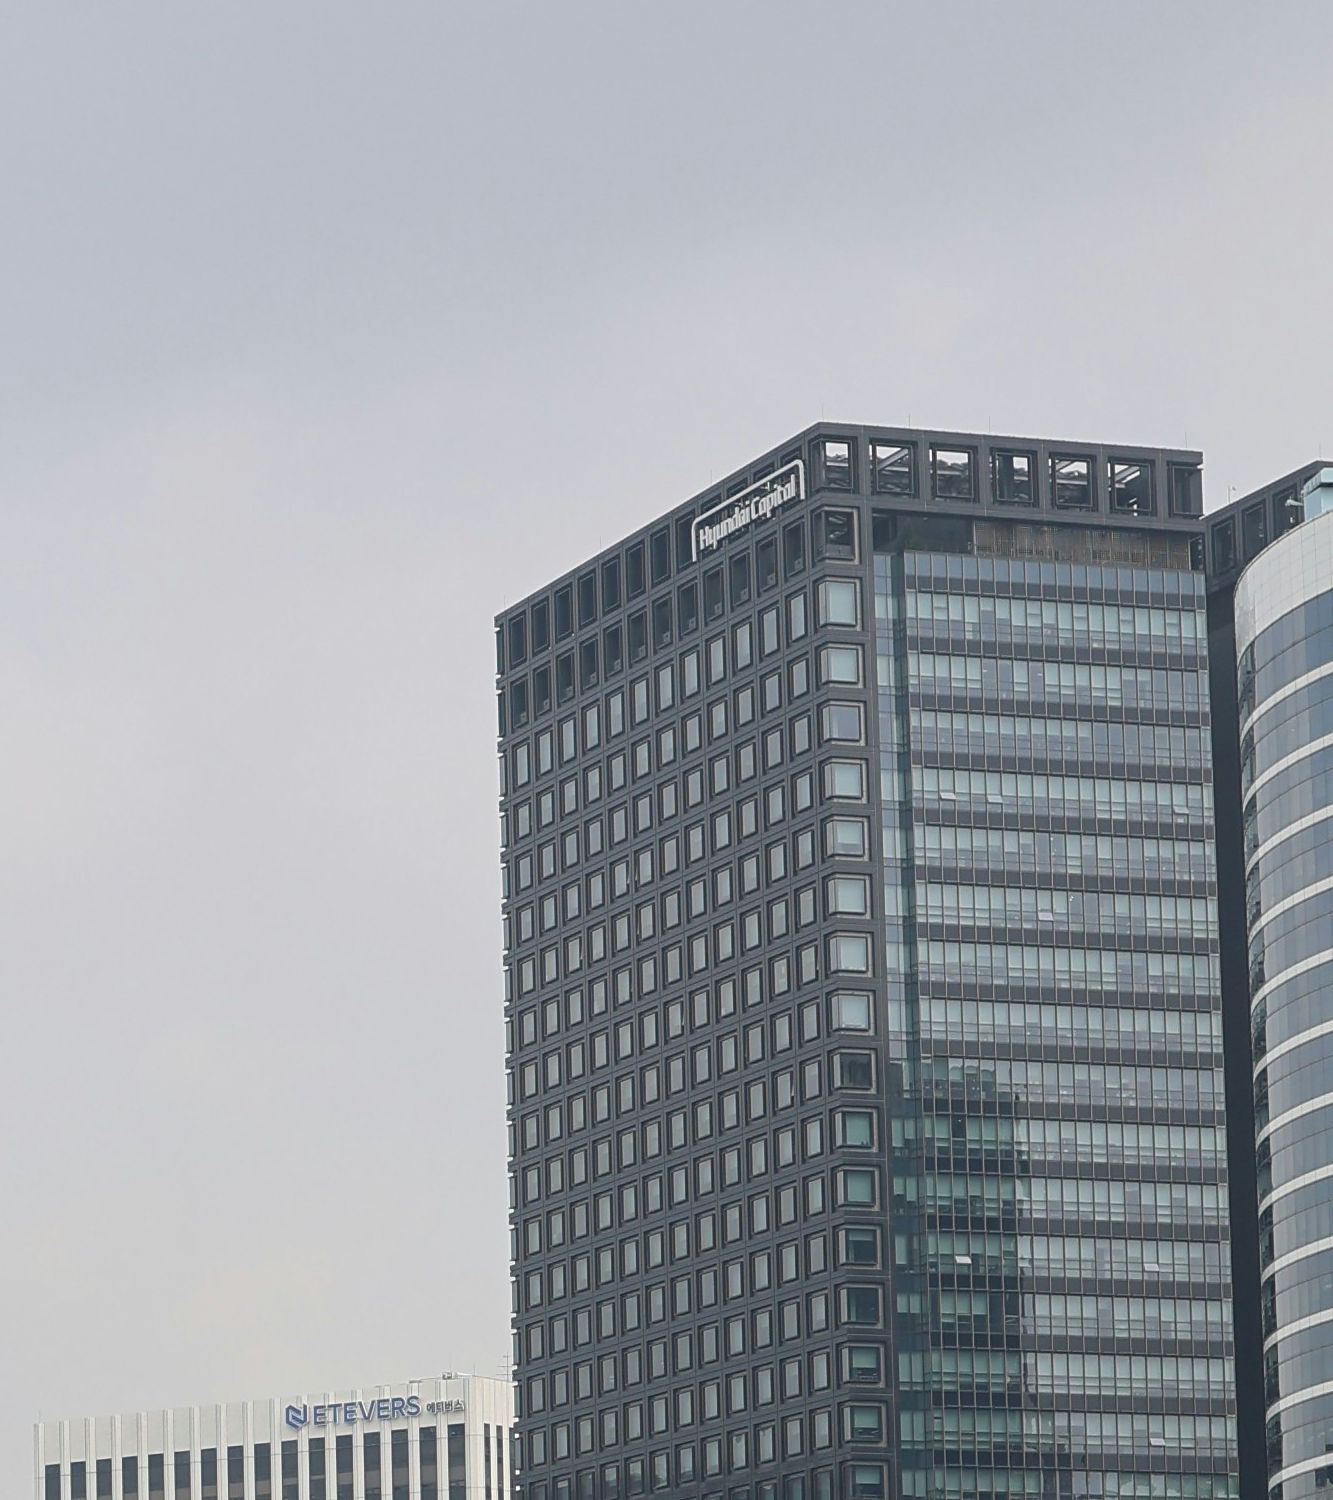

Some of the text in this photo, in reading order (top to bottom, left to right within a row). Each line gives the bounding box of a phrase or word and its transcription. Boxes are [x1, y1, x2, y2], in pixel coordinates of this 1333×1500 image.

[699, 473, 796, 550] Hyundai Capital
[313, 1395, 466, 1426] ETEVERS 에티버스
